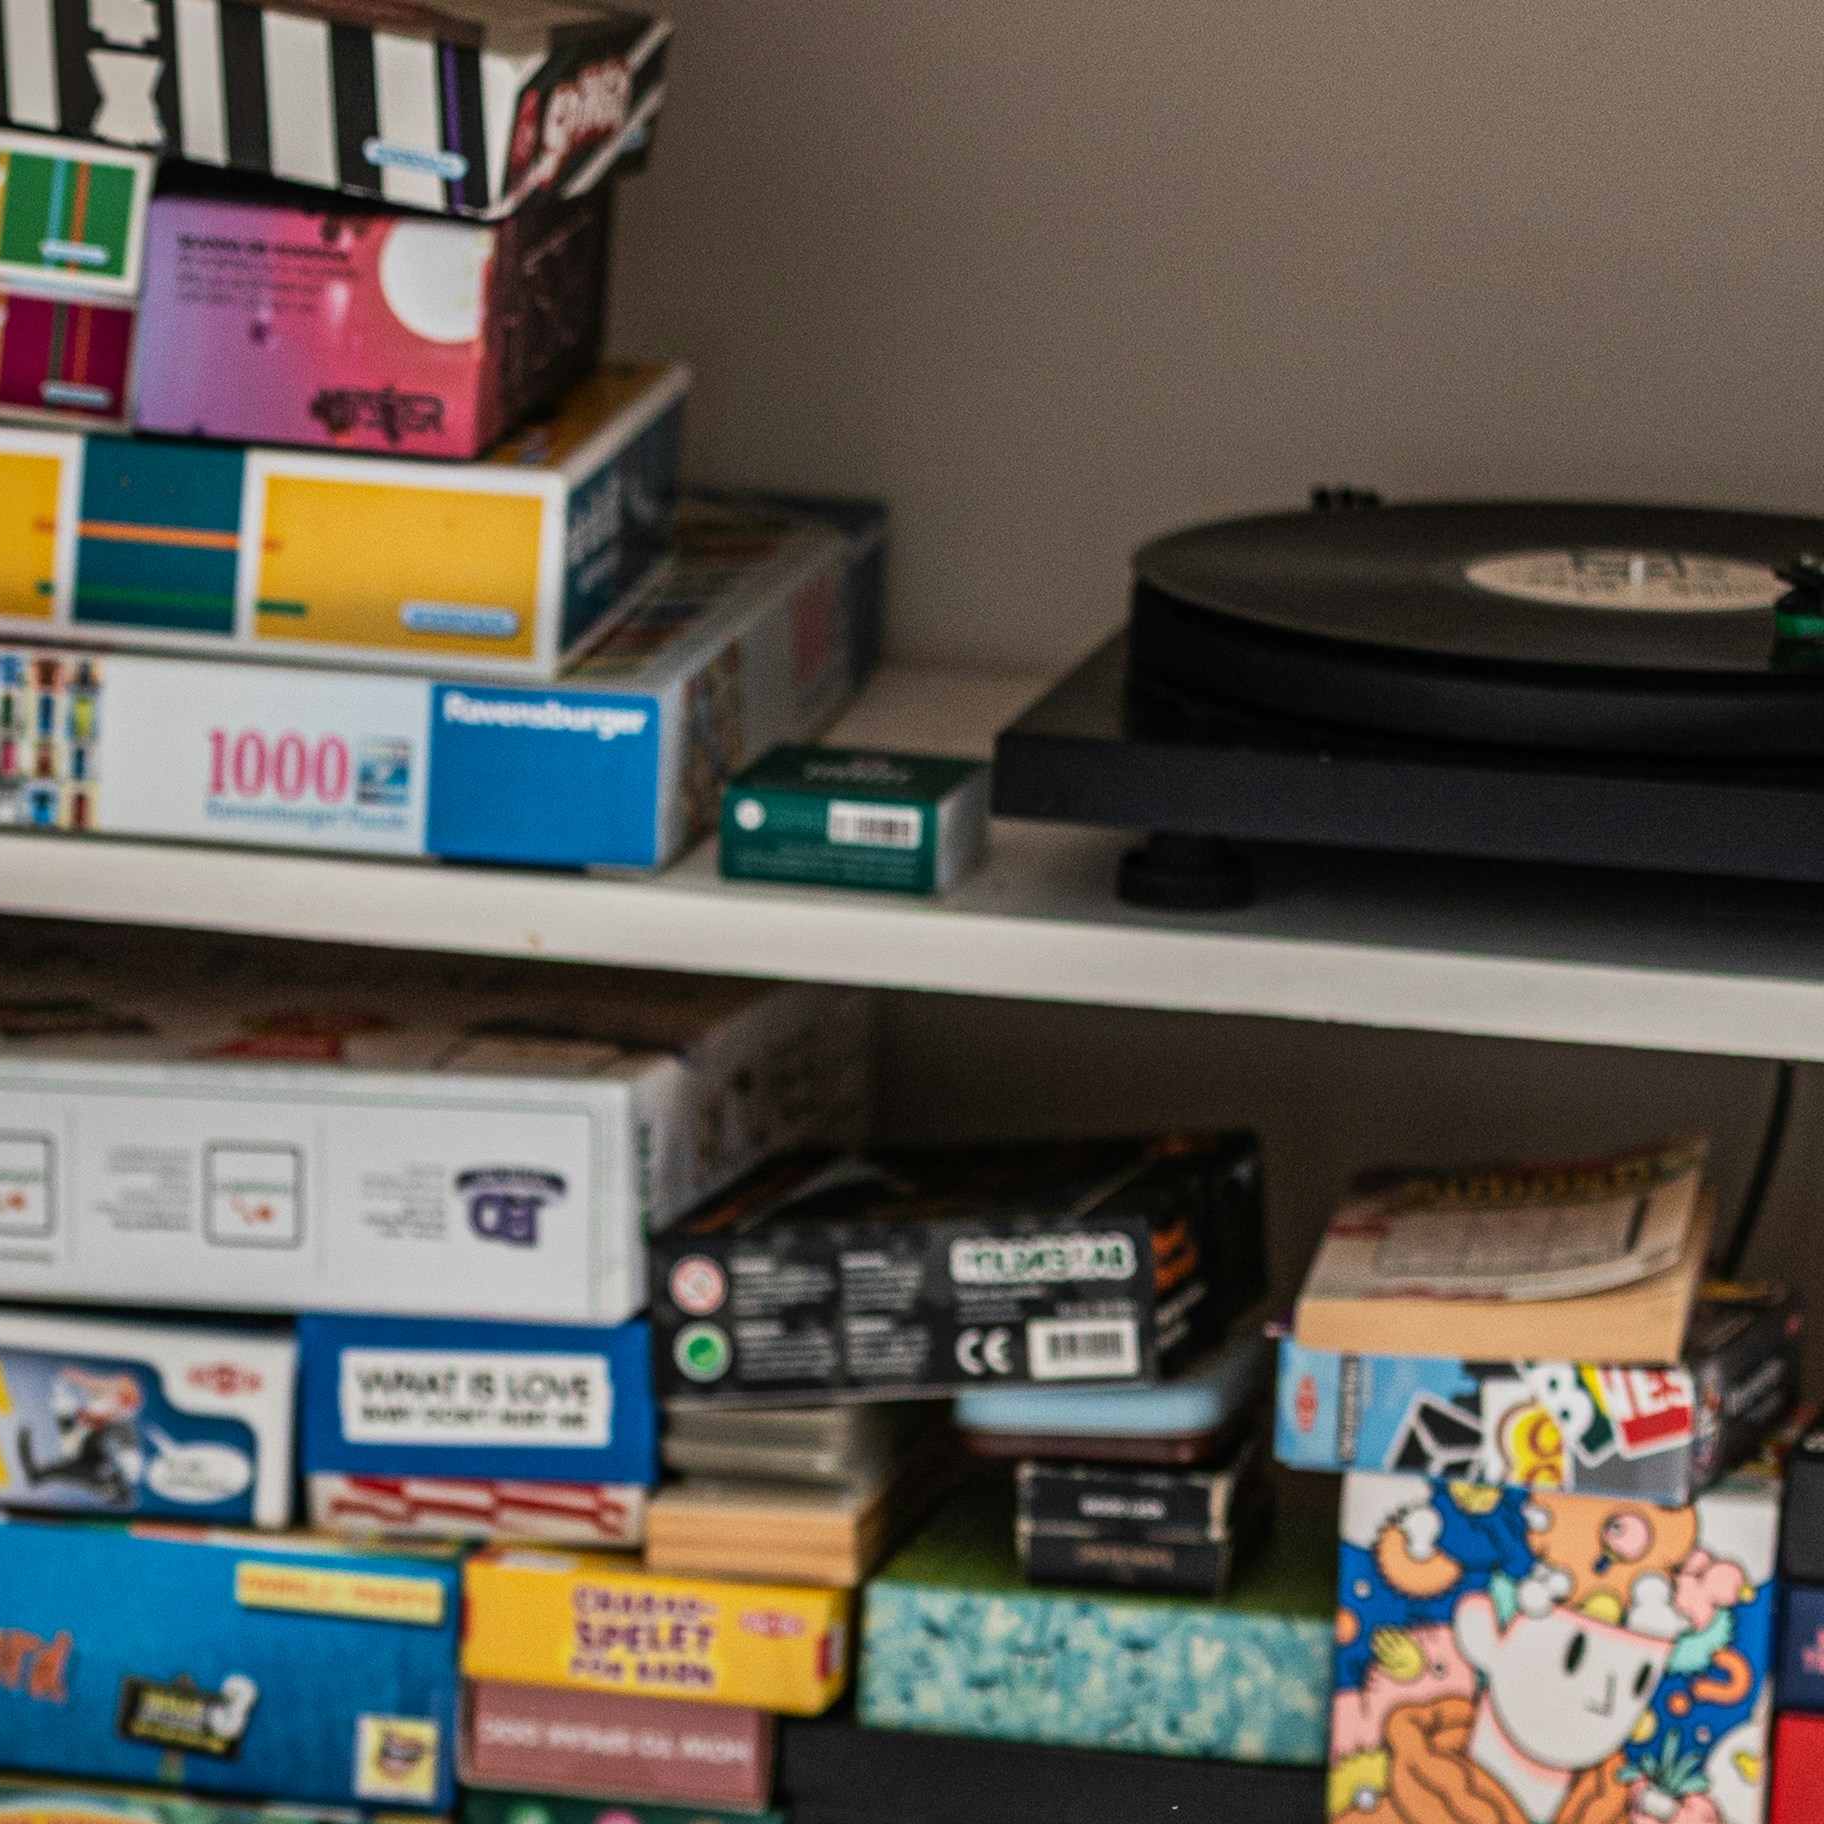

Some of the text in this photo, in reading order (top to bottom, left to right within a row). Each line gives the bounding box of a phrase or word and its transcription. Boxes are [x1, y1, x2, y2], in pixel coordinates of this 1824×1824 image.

[444, 690, 648, 741] Ravensburger
[207, 728, 350, 804] 1000
[355, 1369, 589, 1404] WHAT IS LOVE
[574, 1615, 714, 1653] SPELET
